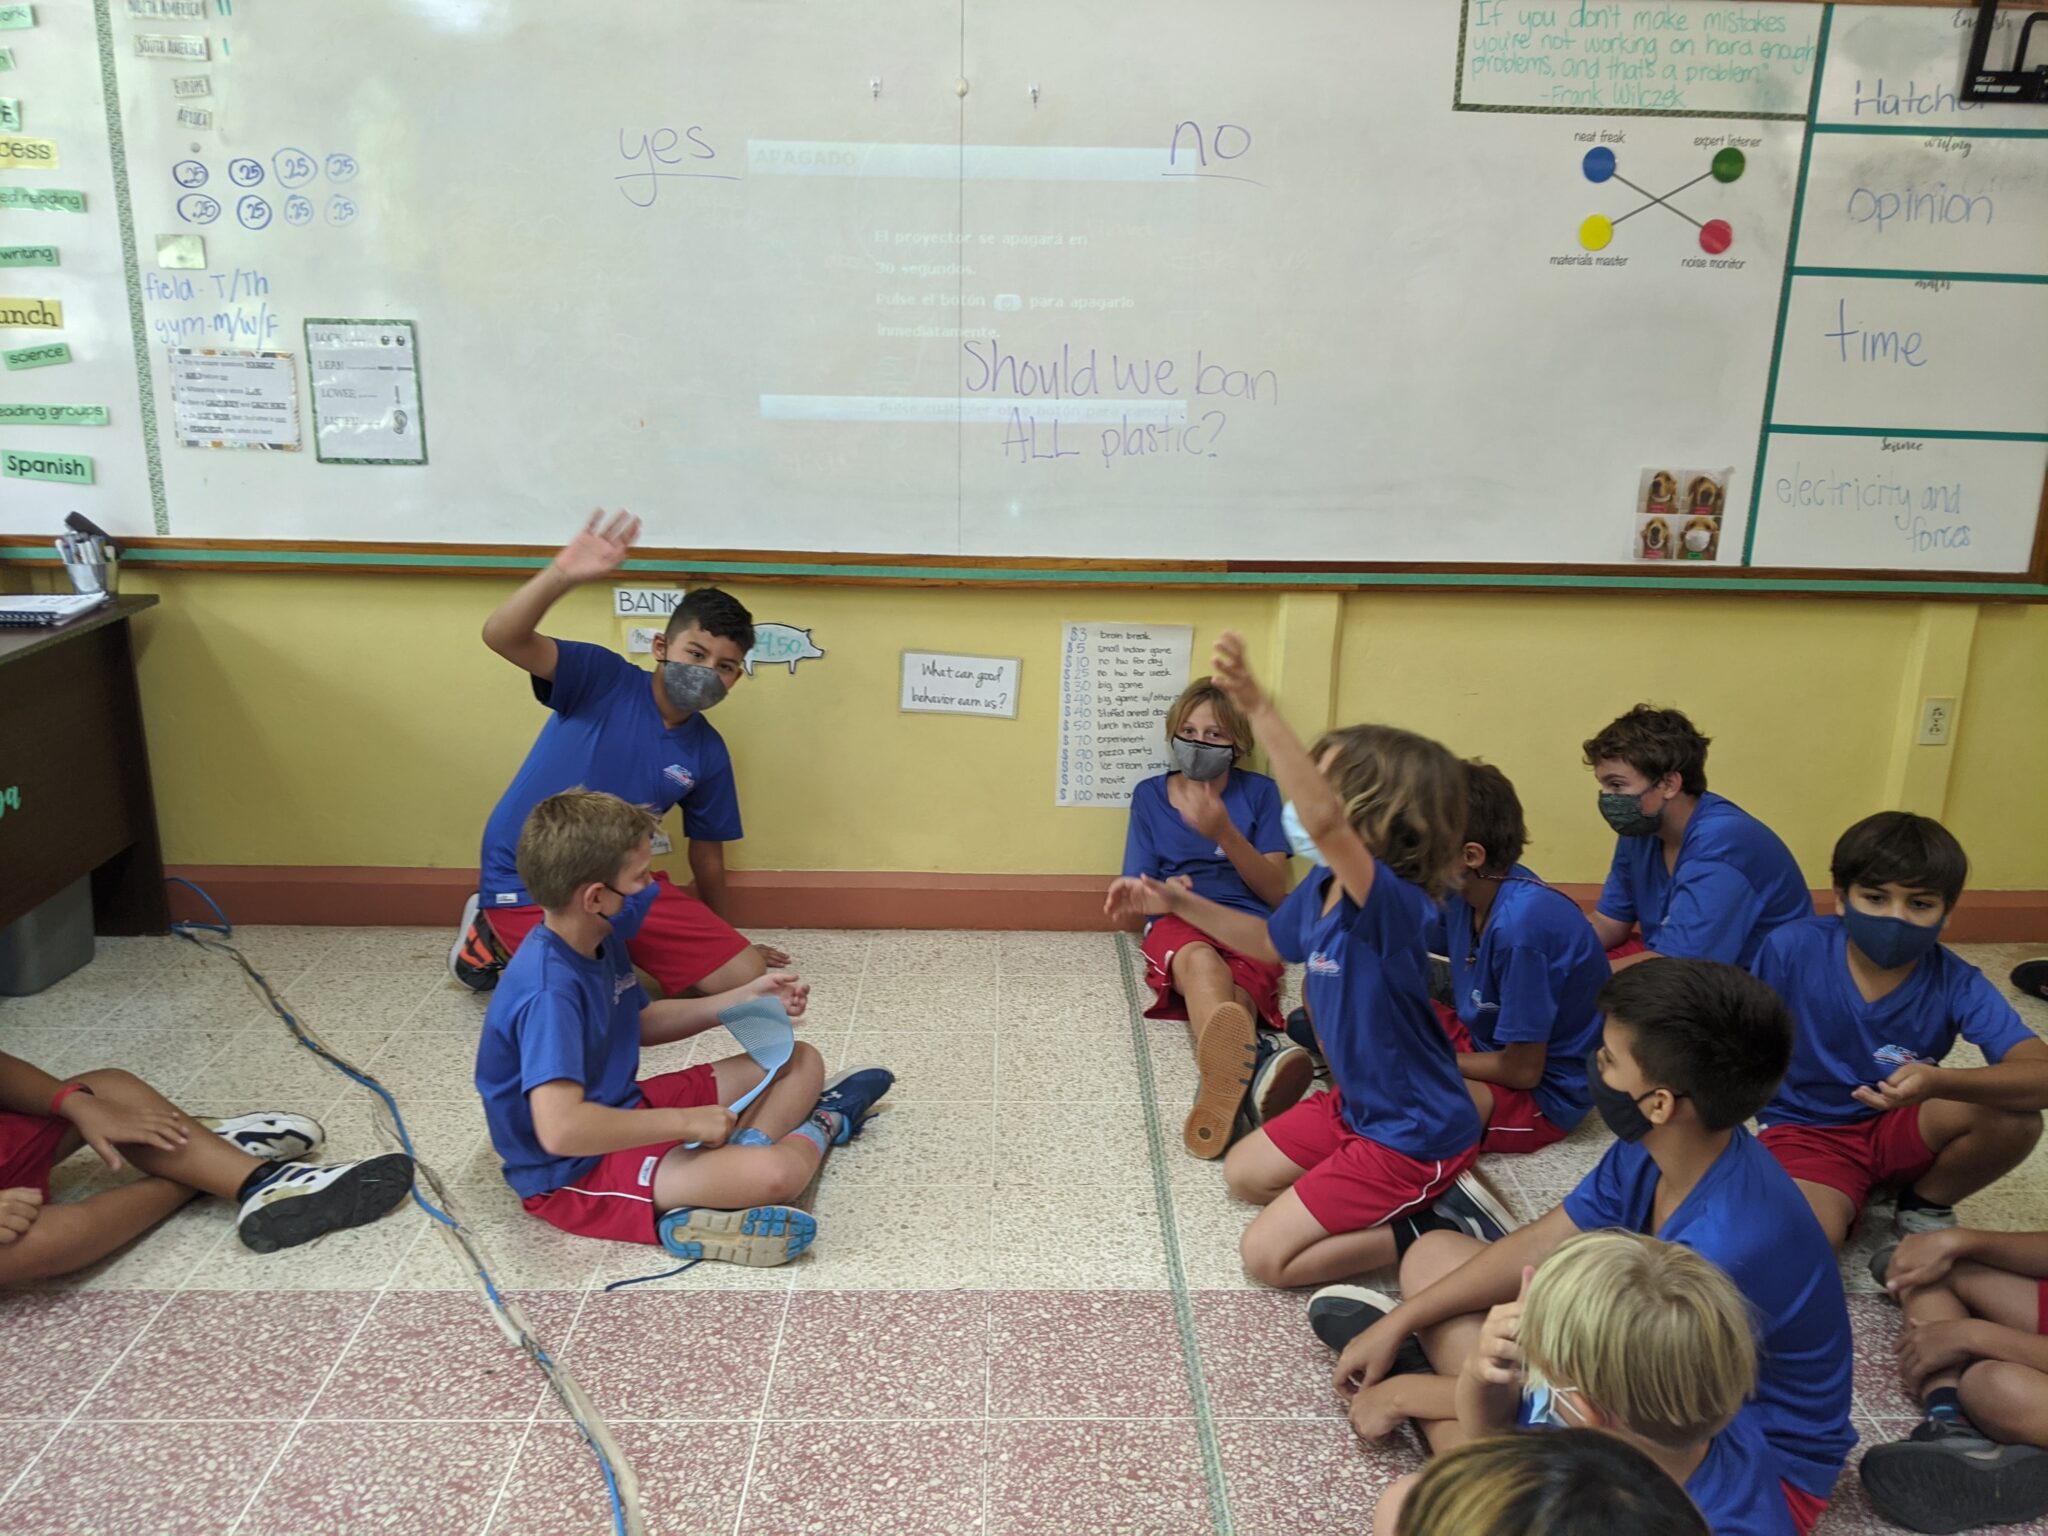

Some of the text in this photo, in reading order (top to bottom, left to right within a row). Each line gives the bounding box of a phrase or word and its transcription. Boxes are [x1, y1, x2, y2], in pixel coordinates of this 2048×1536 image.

[1519, 9, 1556, 38] you
[1569, 0, 1622, 28] don't
[1633, 5, 1688, 31] make
[1704, 8, 1786, 33] mistakes
[1542, 28, 1577, 51] not
[1585, 32, 1657, 64] working
[1670, 37, 1695, 57] on
[1707, 34, 1754, 56] hard
[1562, 56, 1600, 80] and
[1662, 63, 1678, 81] a
[1170, 120, 1252, 167] no
[1574, 130, 1626, 144] neat freak
[1694, 134, 1763, 150] expert listener
[618, 125, 716, 207] yes
[756, 148, 857, 166] APAGADO
[895, 230, 970, 247] proyector
[979, 234, 995, 245] se
[1069, 235, 1088, 247] en
[876, 262, 895, 274] 30
[1550, 252, 1629, 268] materials master
[1681, 256, 1747, 270] noise monitor
[921, 293, 935, 306] el
[1029, 296, 1064, 310] para
[1824, 298, 1928, 367] time
[963, 339, 1099, 400] Should
[1195, 350, 1278, 405] ban
[1001, 406, 1227, 468] ALL plastic?
[8, 455, 86, 476] Spanish
[1776, 462, 1961, 531] electricity and
[1906, 516, 1971, 552] forces
[619, 591, 680, 613] BANK
[922, 660, 1004, 688] What can good
[911, 686, 956, 705] behavior
